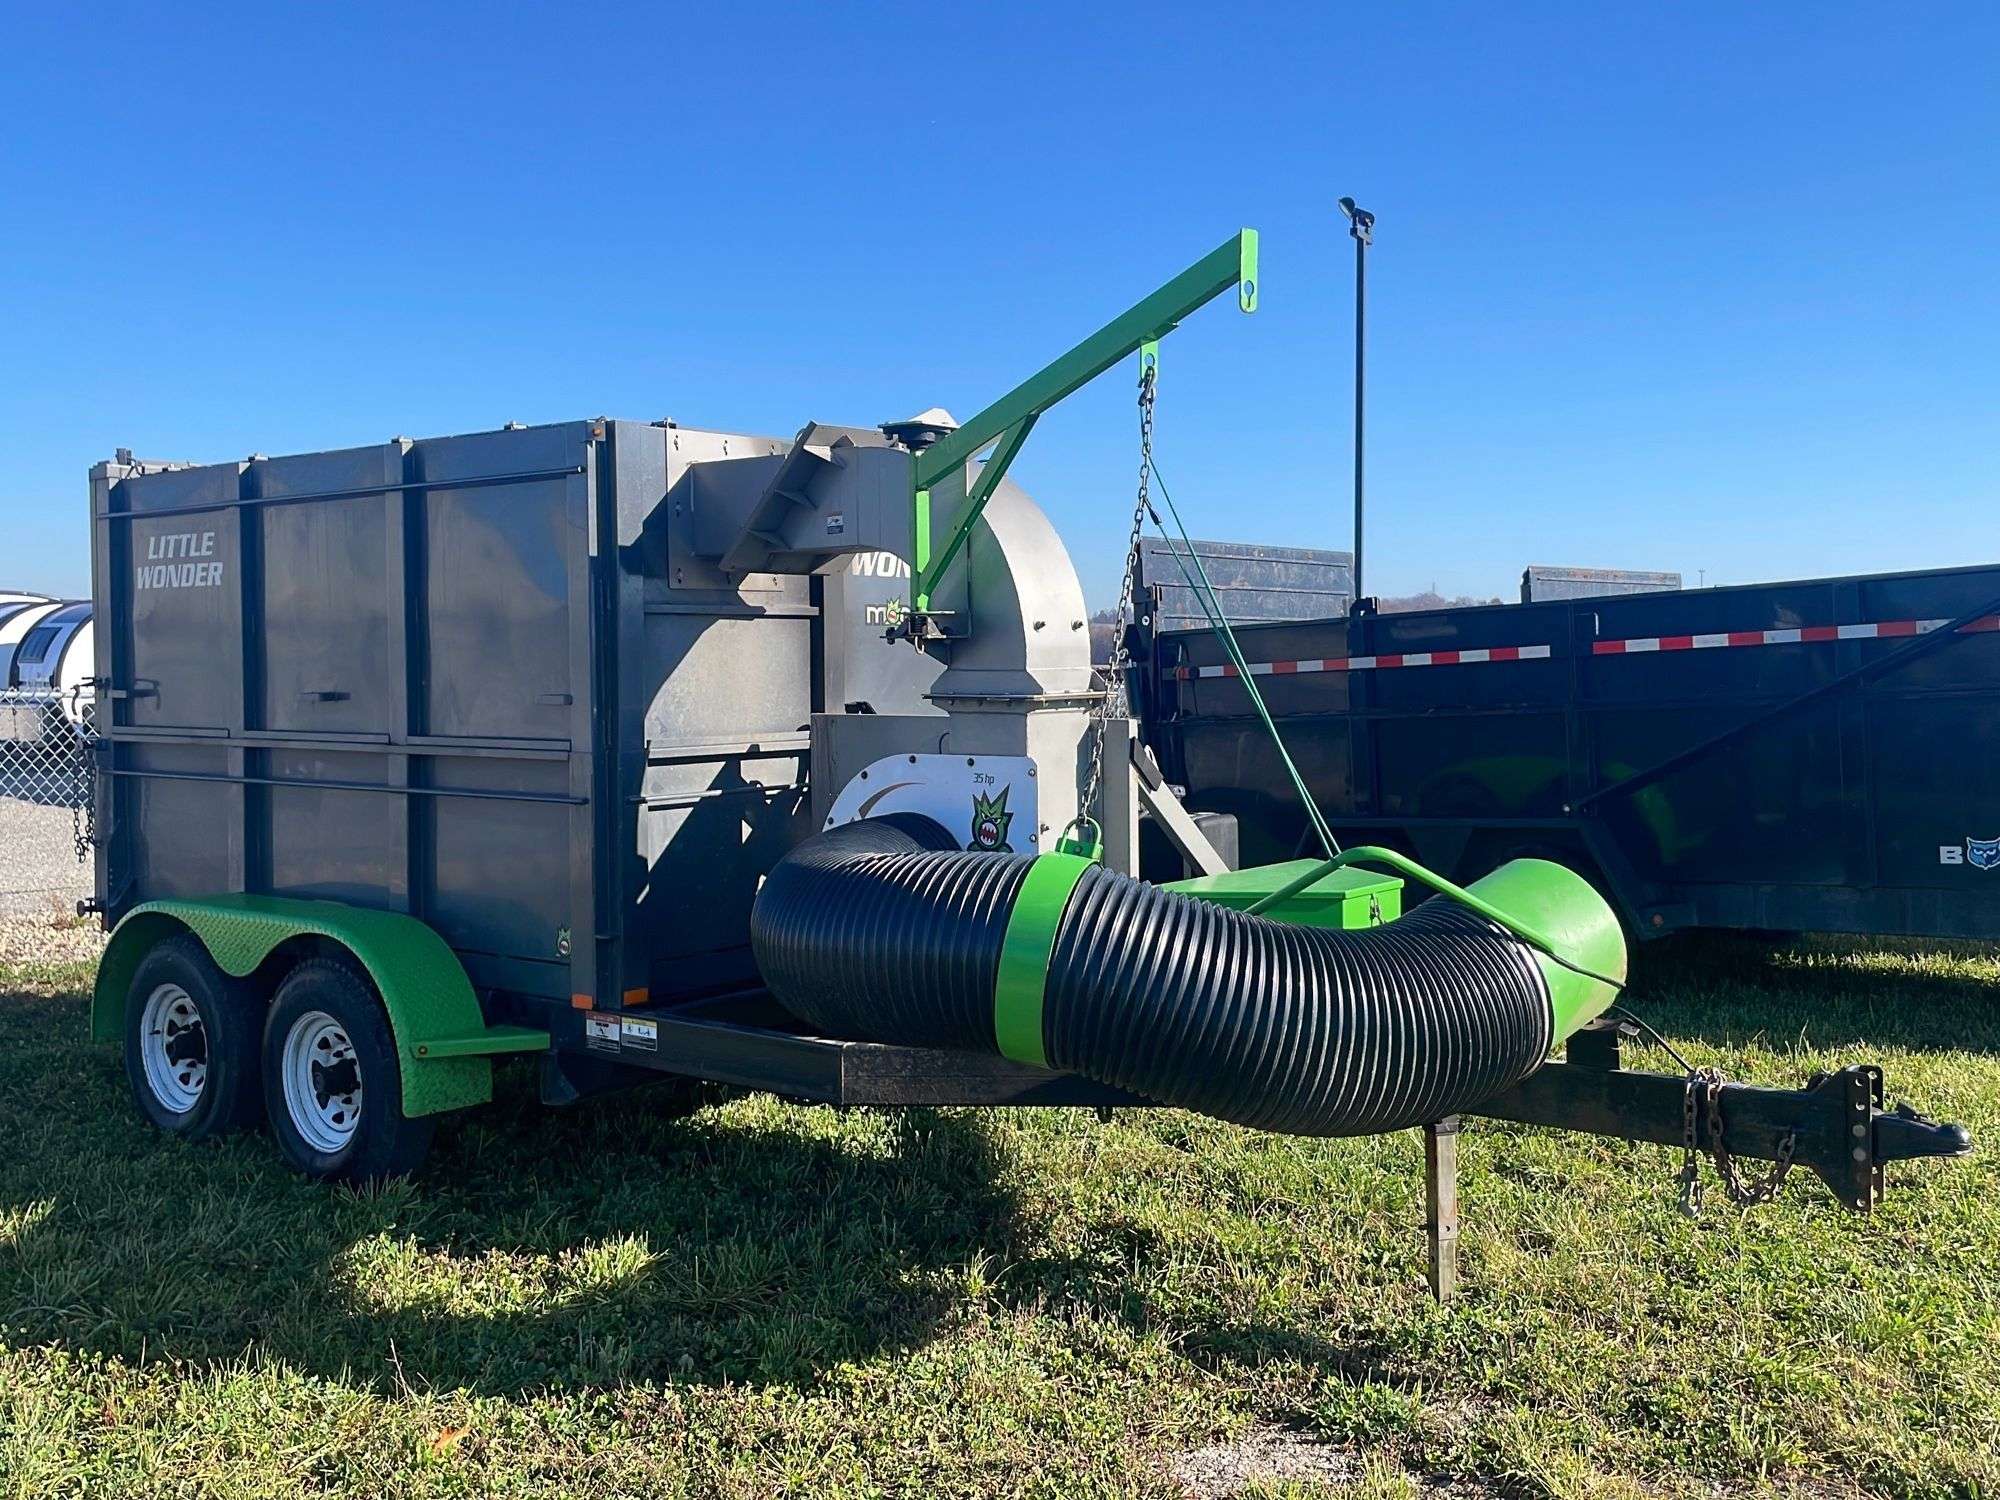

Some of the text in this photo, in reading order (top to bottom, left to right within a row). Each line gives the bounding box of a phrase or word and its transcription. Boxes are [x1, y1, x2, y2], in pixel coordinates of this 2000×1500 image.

[148, 532, 215, 560] LITTLE
[137, 561, 224, 589] WONDER
[973, 772, 995, 786] 35 hp
